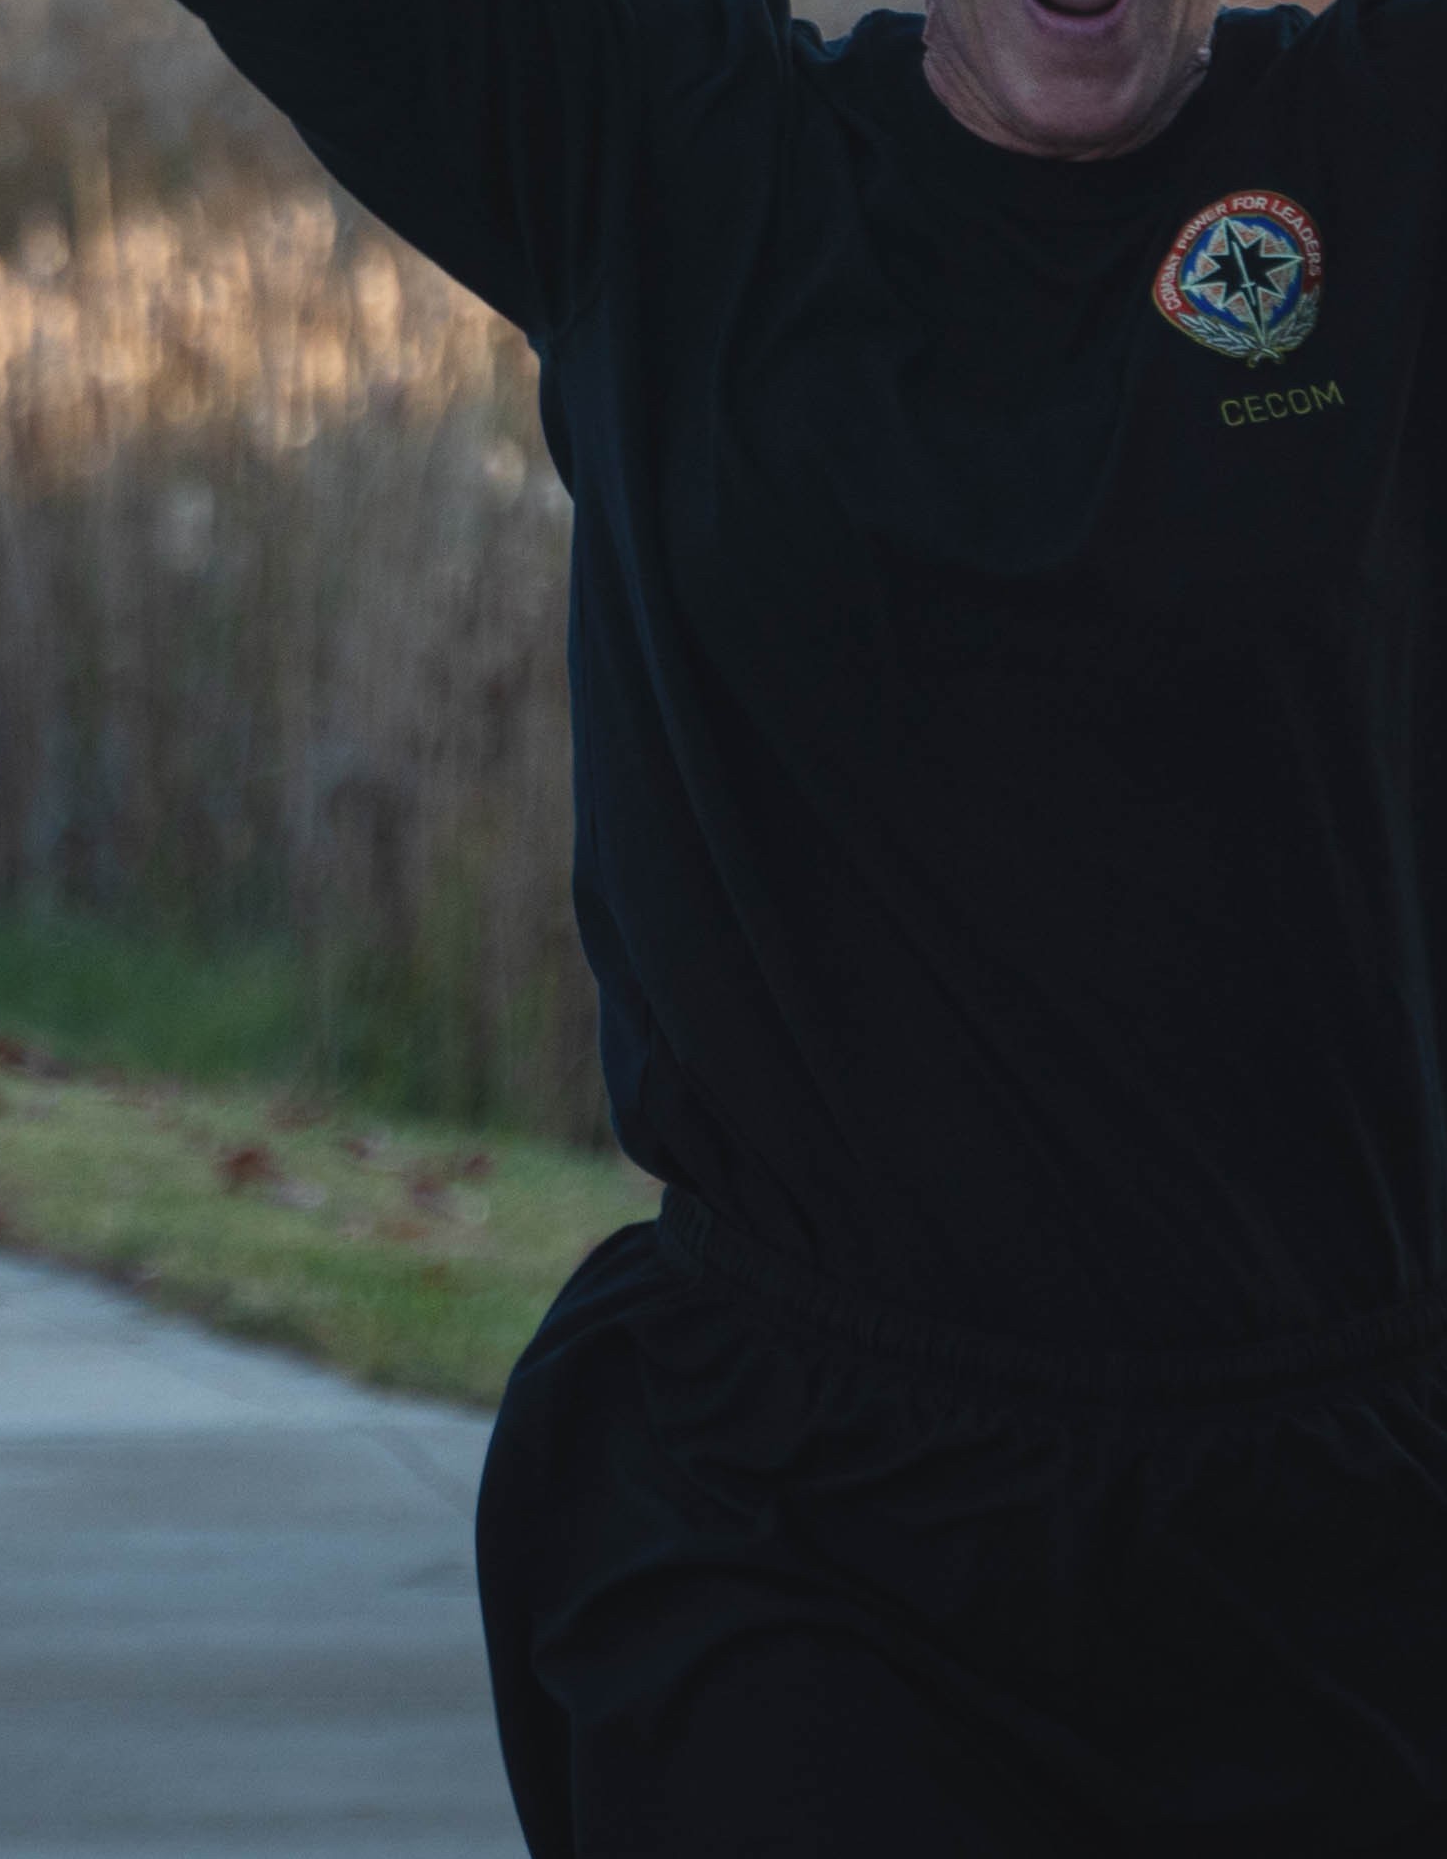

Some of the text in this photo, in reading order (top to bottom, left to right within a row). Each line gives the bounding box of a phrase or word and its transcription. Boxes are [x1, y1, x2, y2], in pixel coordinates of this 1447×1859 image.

[1176, 203, 1228, 250] POWER
[1232, 196, 1268, 210] FOR
[1220, 381, 1345, 427] CECOM
